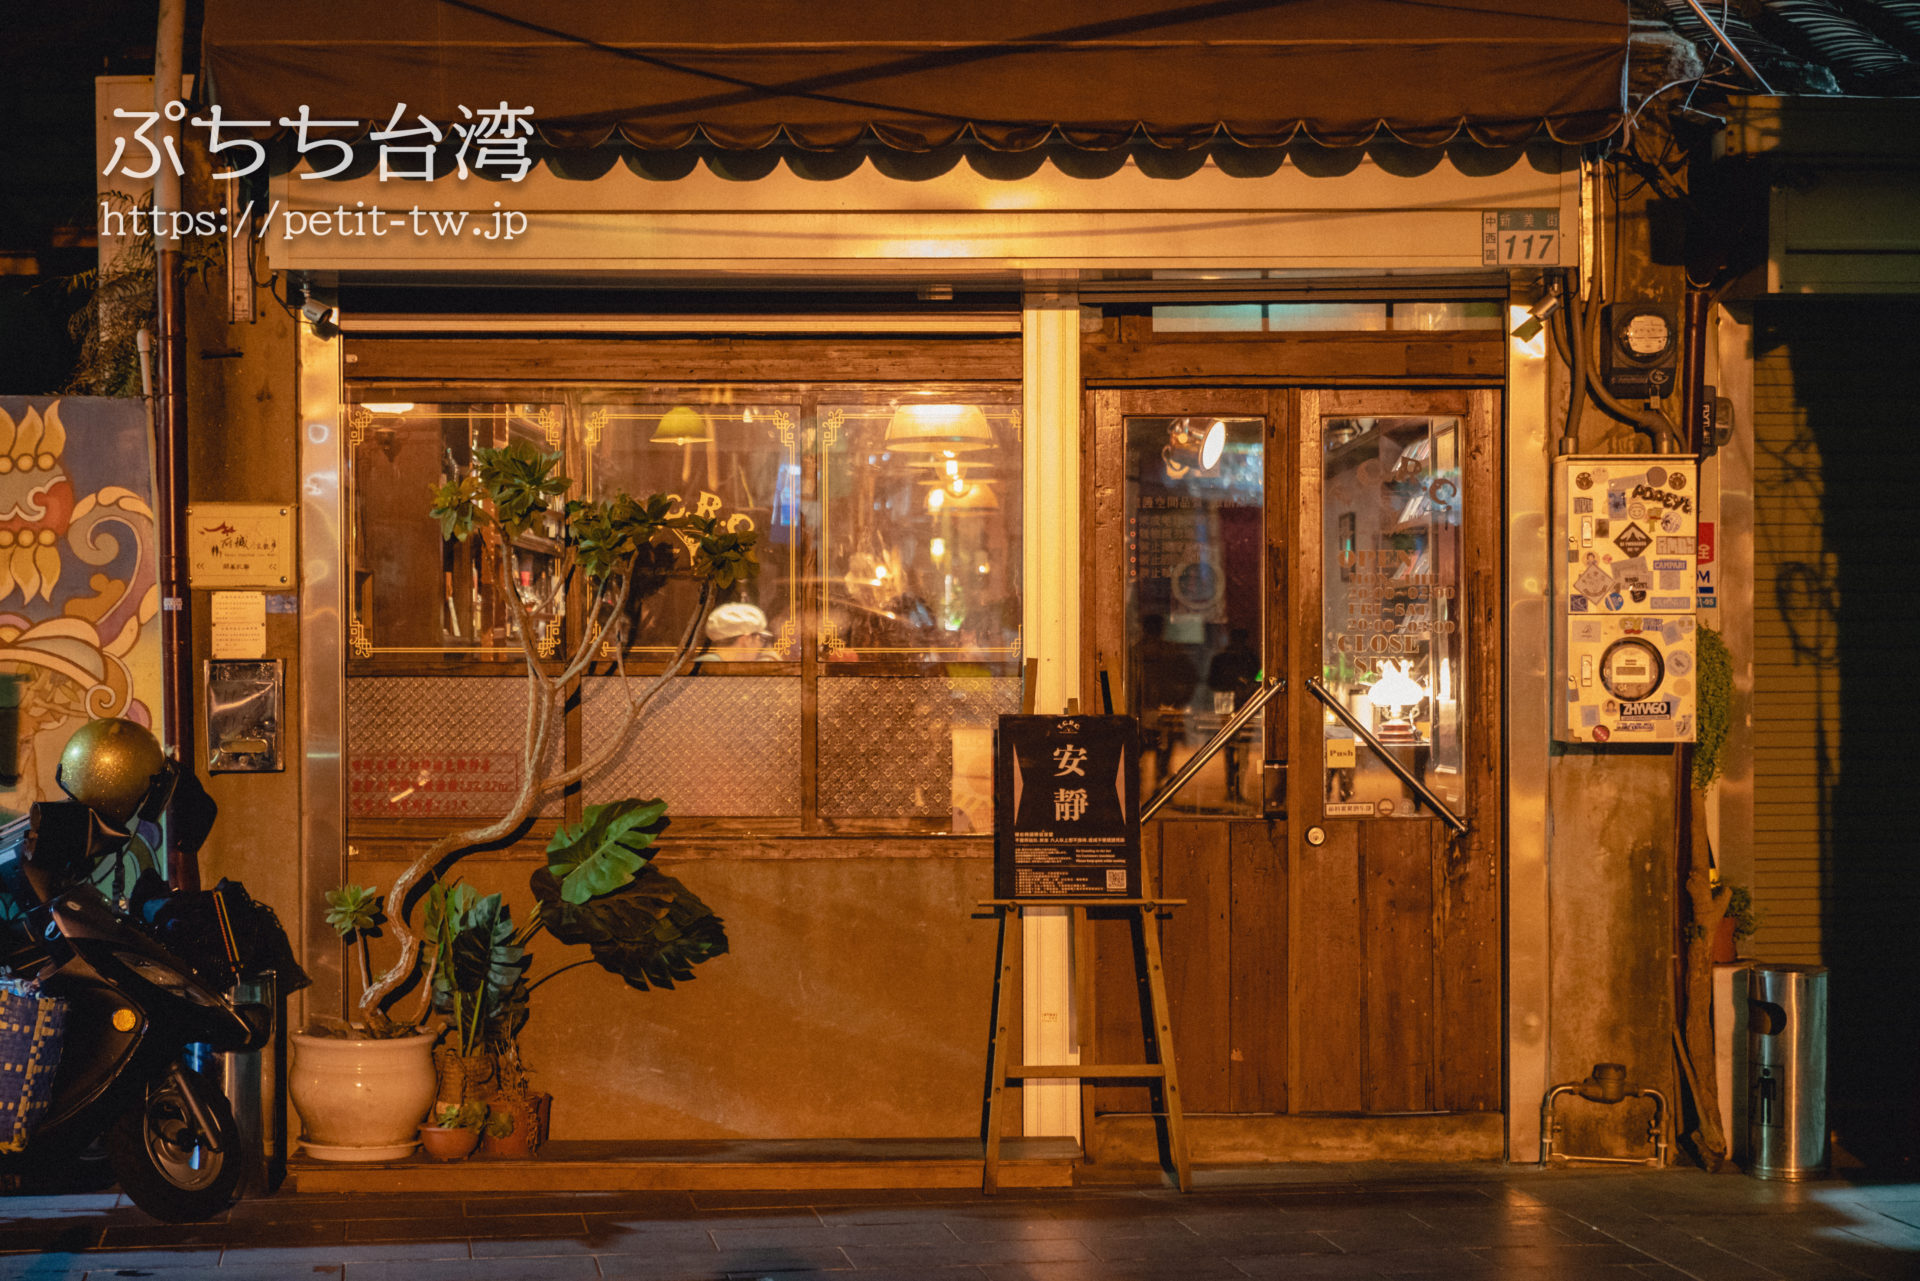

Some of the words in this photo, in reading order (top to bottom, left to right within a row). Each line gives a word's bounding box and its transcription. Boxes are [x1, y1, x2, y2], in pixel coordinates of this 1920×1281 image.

[1499, 213, 1558, 228] 新美街
[1485, 216, 1496, 260] 中西區
[1505, 233, 1554, 260] 117
[1337, 549, 1413, 569] OPEN
[1337, 634, 1420, 654] CLOSE
[1329, 749, 1354, 757] Push
[1053, 743, 1089, 822] 安靜
